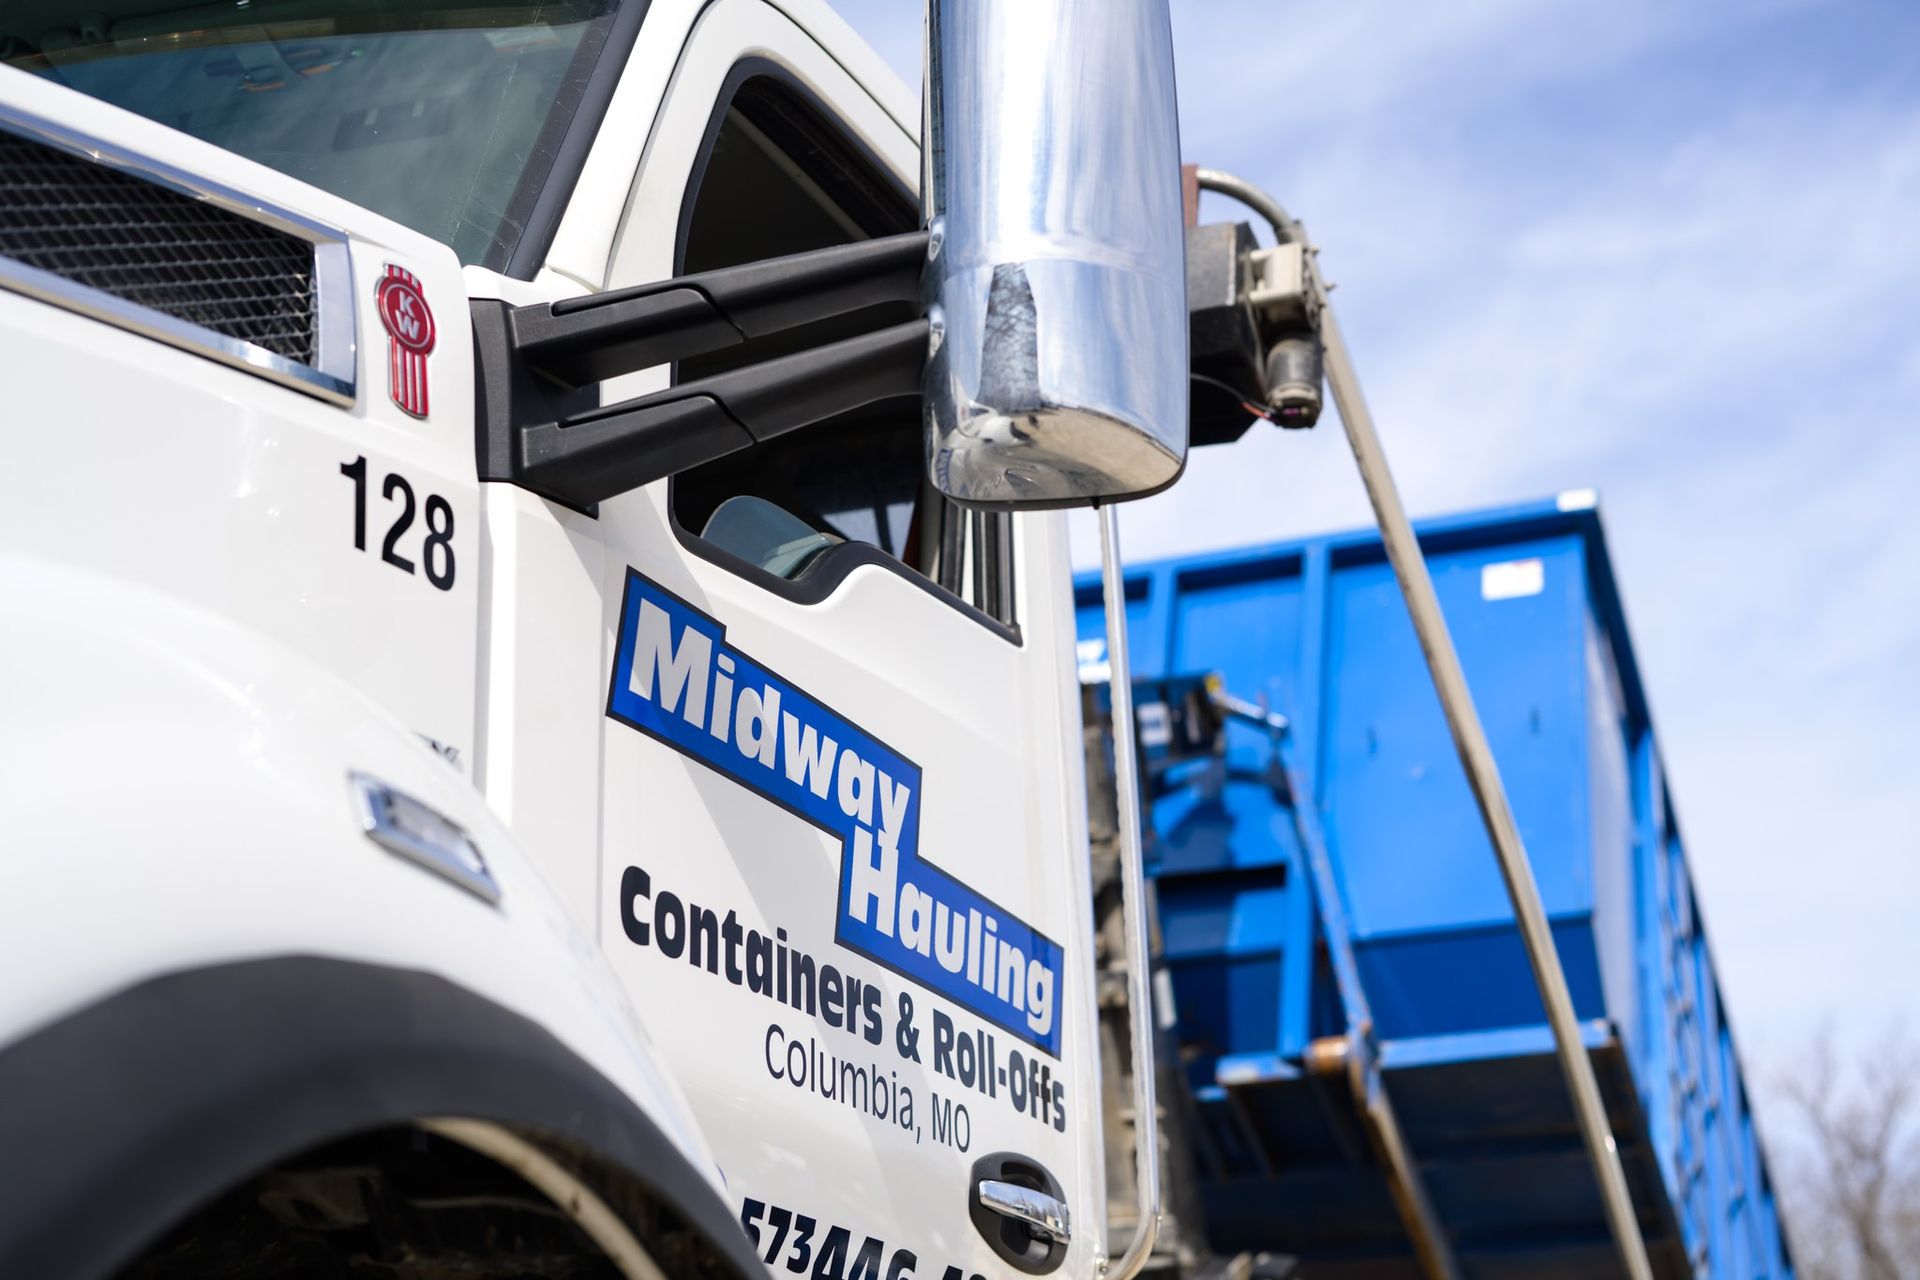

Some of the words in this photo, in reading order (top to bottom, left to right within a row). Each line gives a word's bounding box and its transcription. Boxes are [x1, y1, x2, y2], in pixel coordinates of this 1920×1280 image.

[340, 455, 455, 591] 128
[628, 597, 911, 849] Midway
[620, 865, 882, 1046] Containers
[895, 991, 920, 1065] &
[933, 1008, 1066, 1133] Roll-Offs
[848, 824, 1054, 1036] Hauling
[765, 1023, 921, 1145] Columbia,
[932, 1092, 971, 1154] MO
